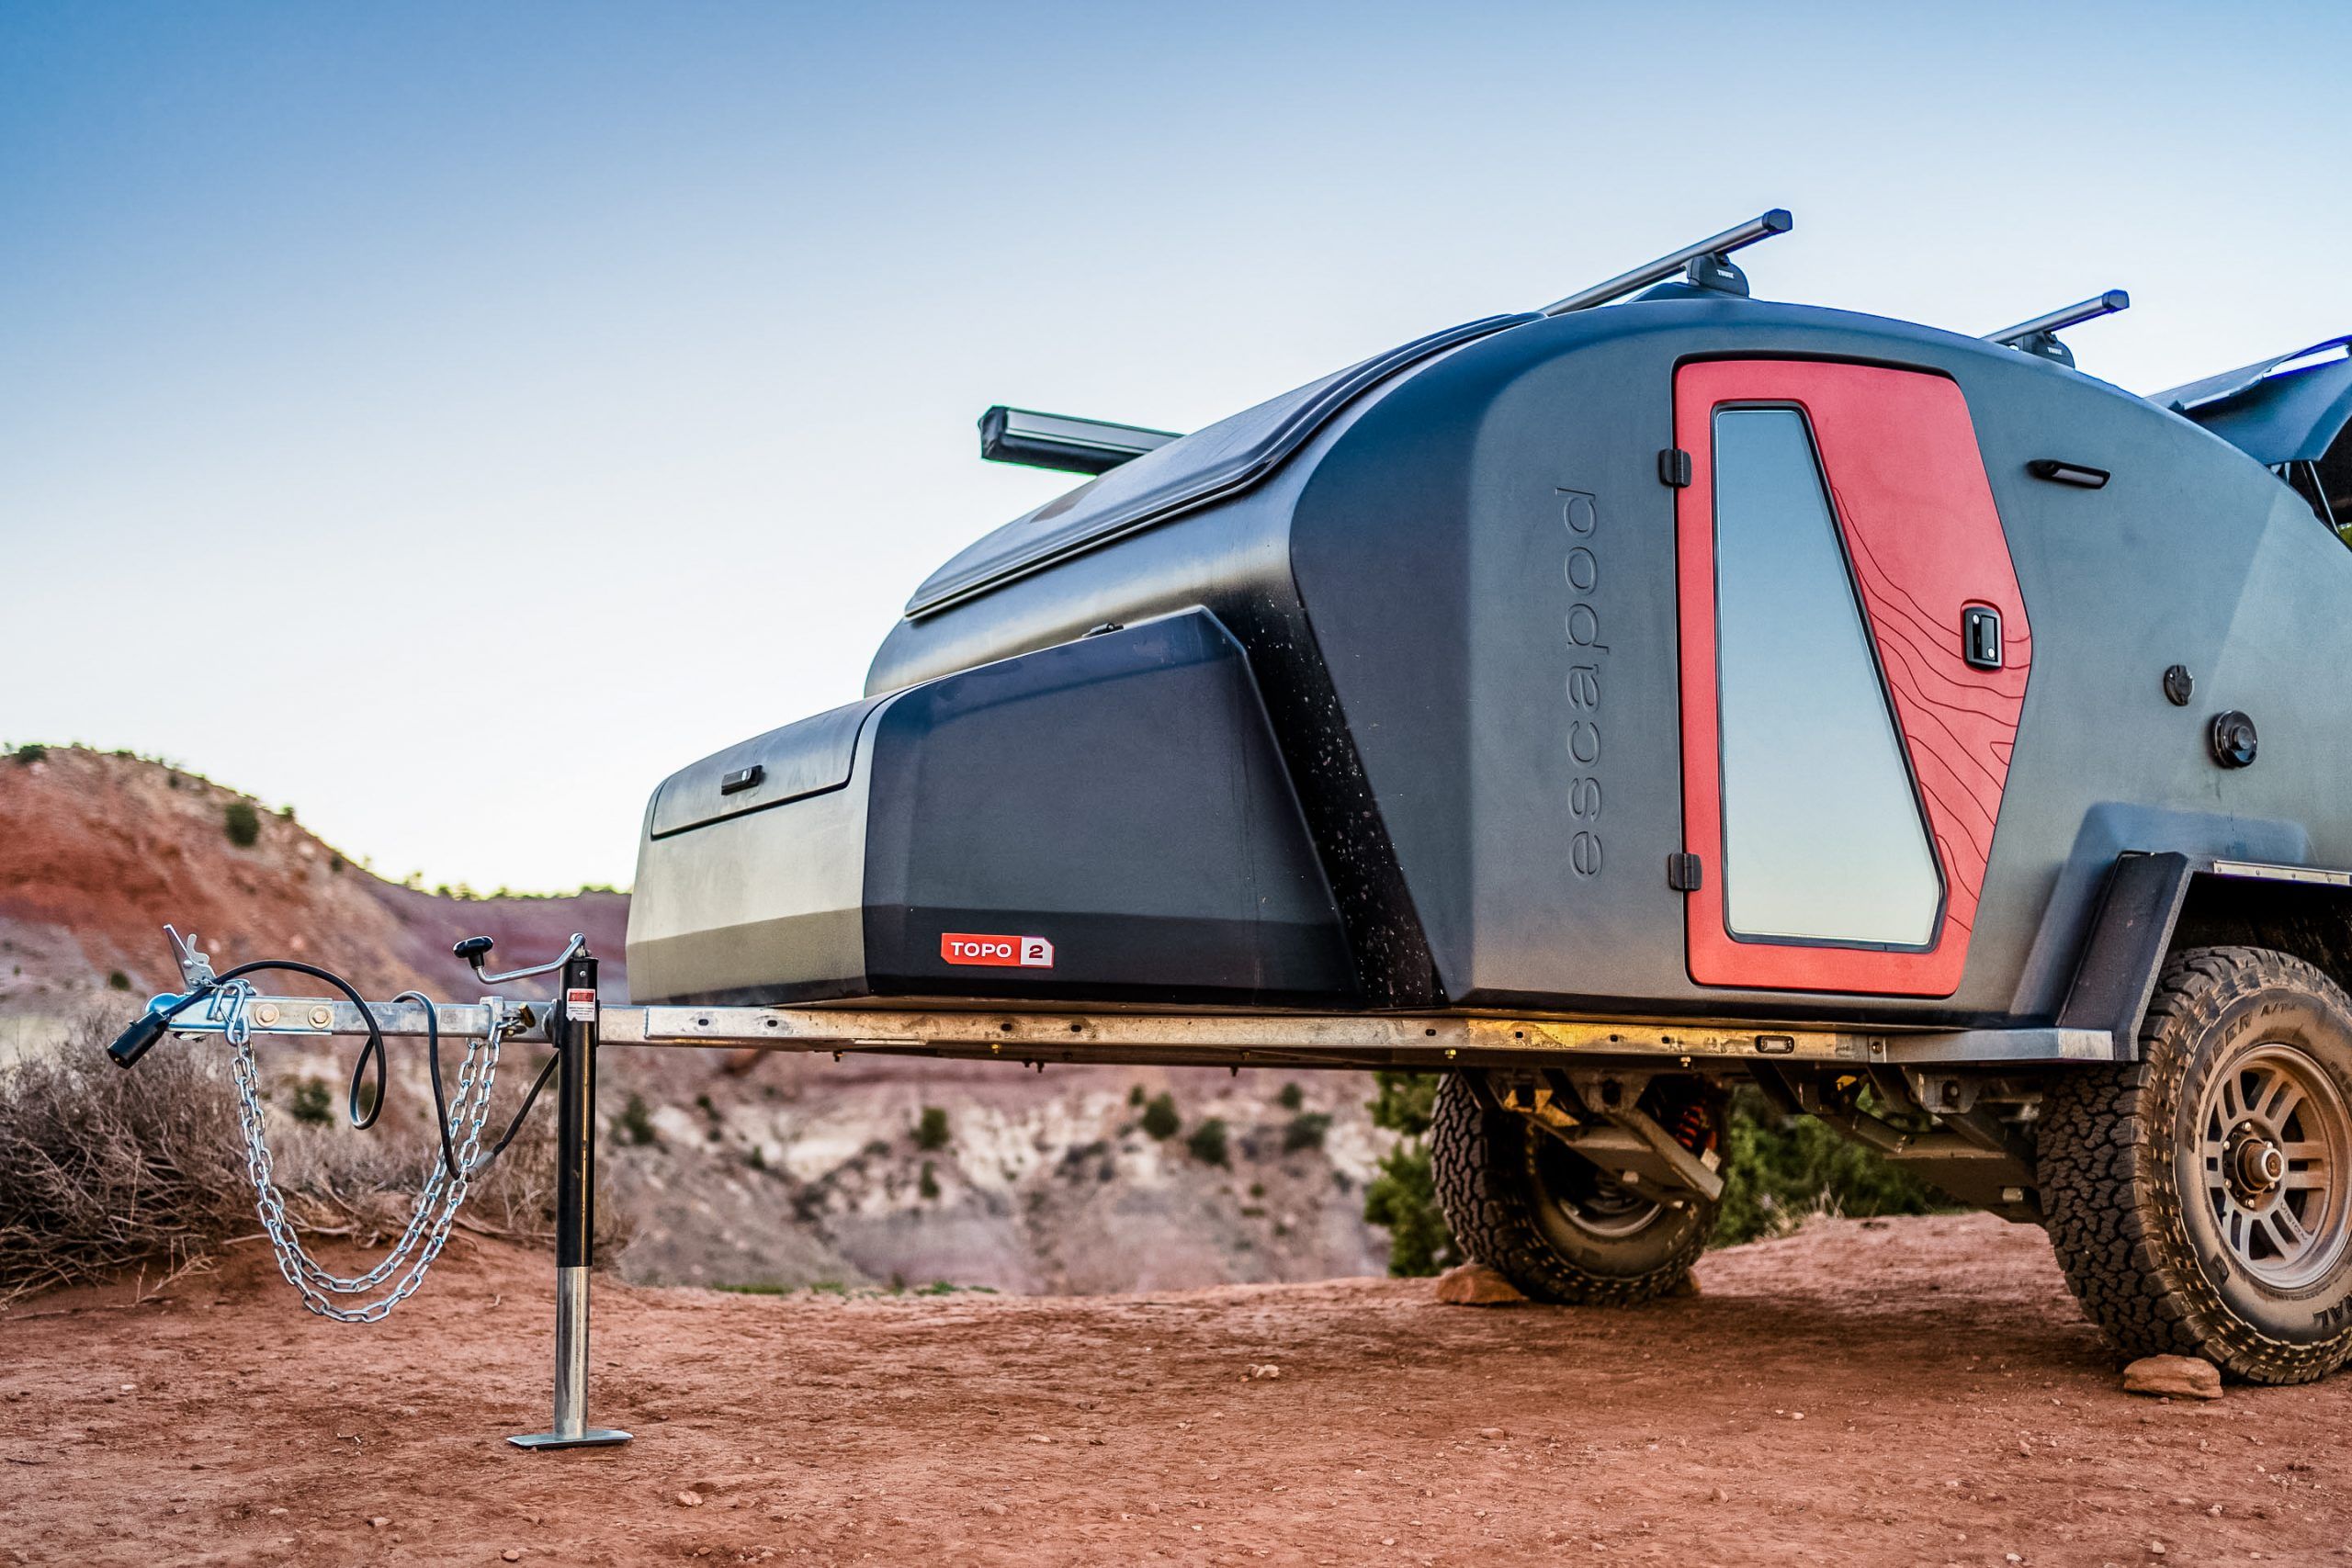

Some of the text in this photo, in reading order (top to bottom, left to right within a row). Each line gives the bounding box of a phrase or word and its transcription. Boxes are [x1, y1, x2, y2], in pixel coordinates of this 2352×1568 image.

[1555, 487, 1610, 881] escapod
[950, 942, 1044, 959] TOPO 2
